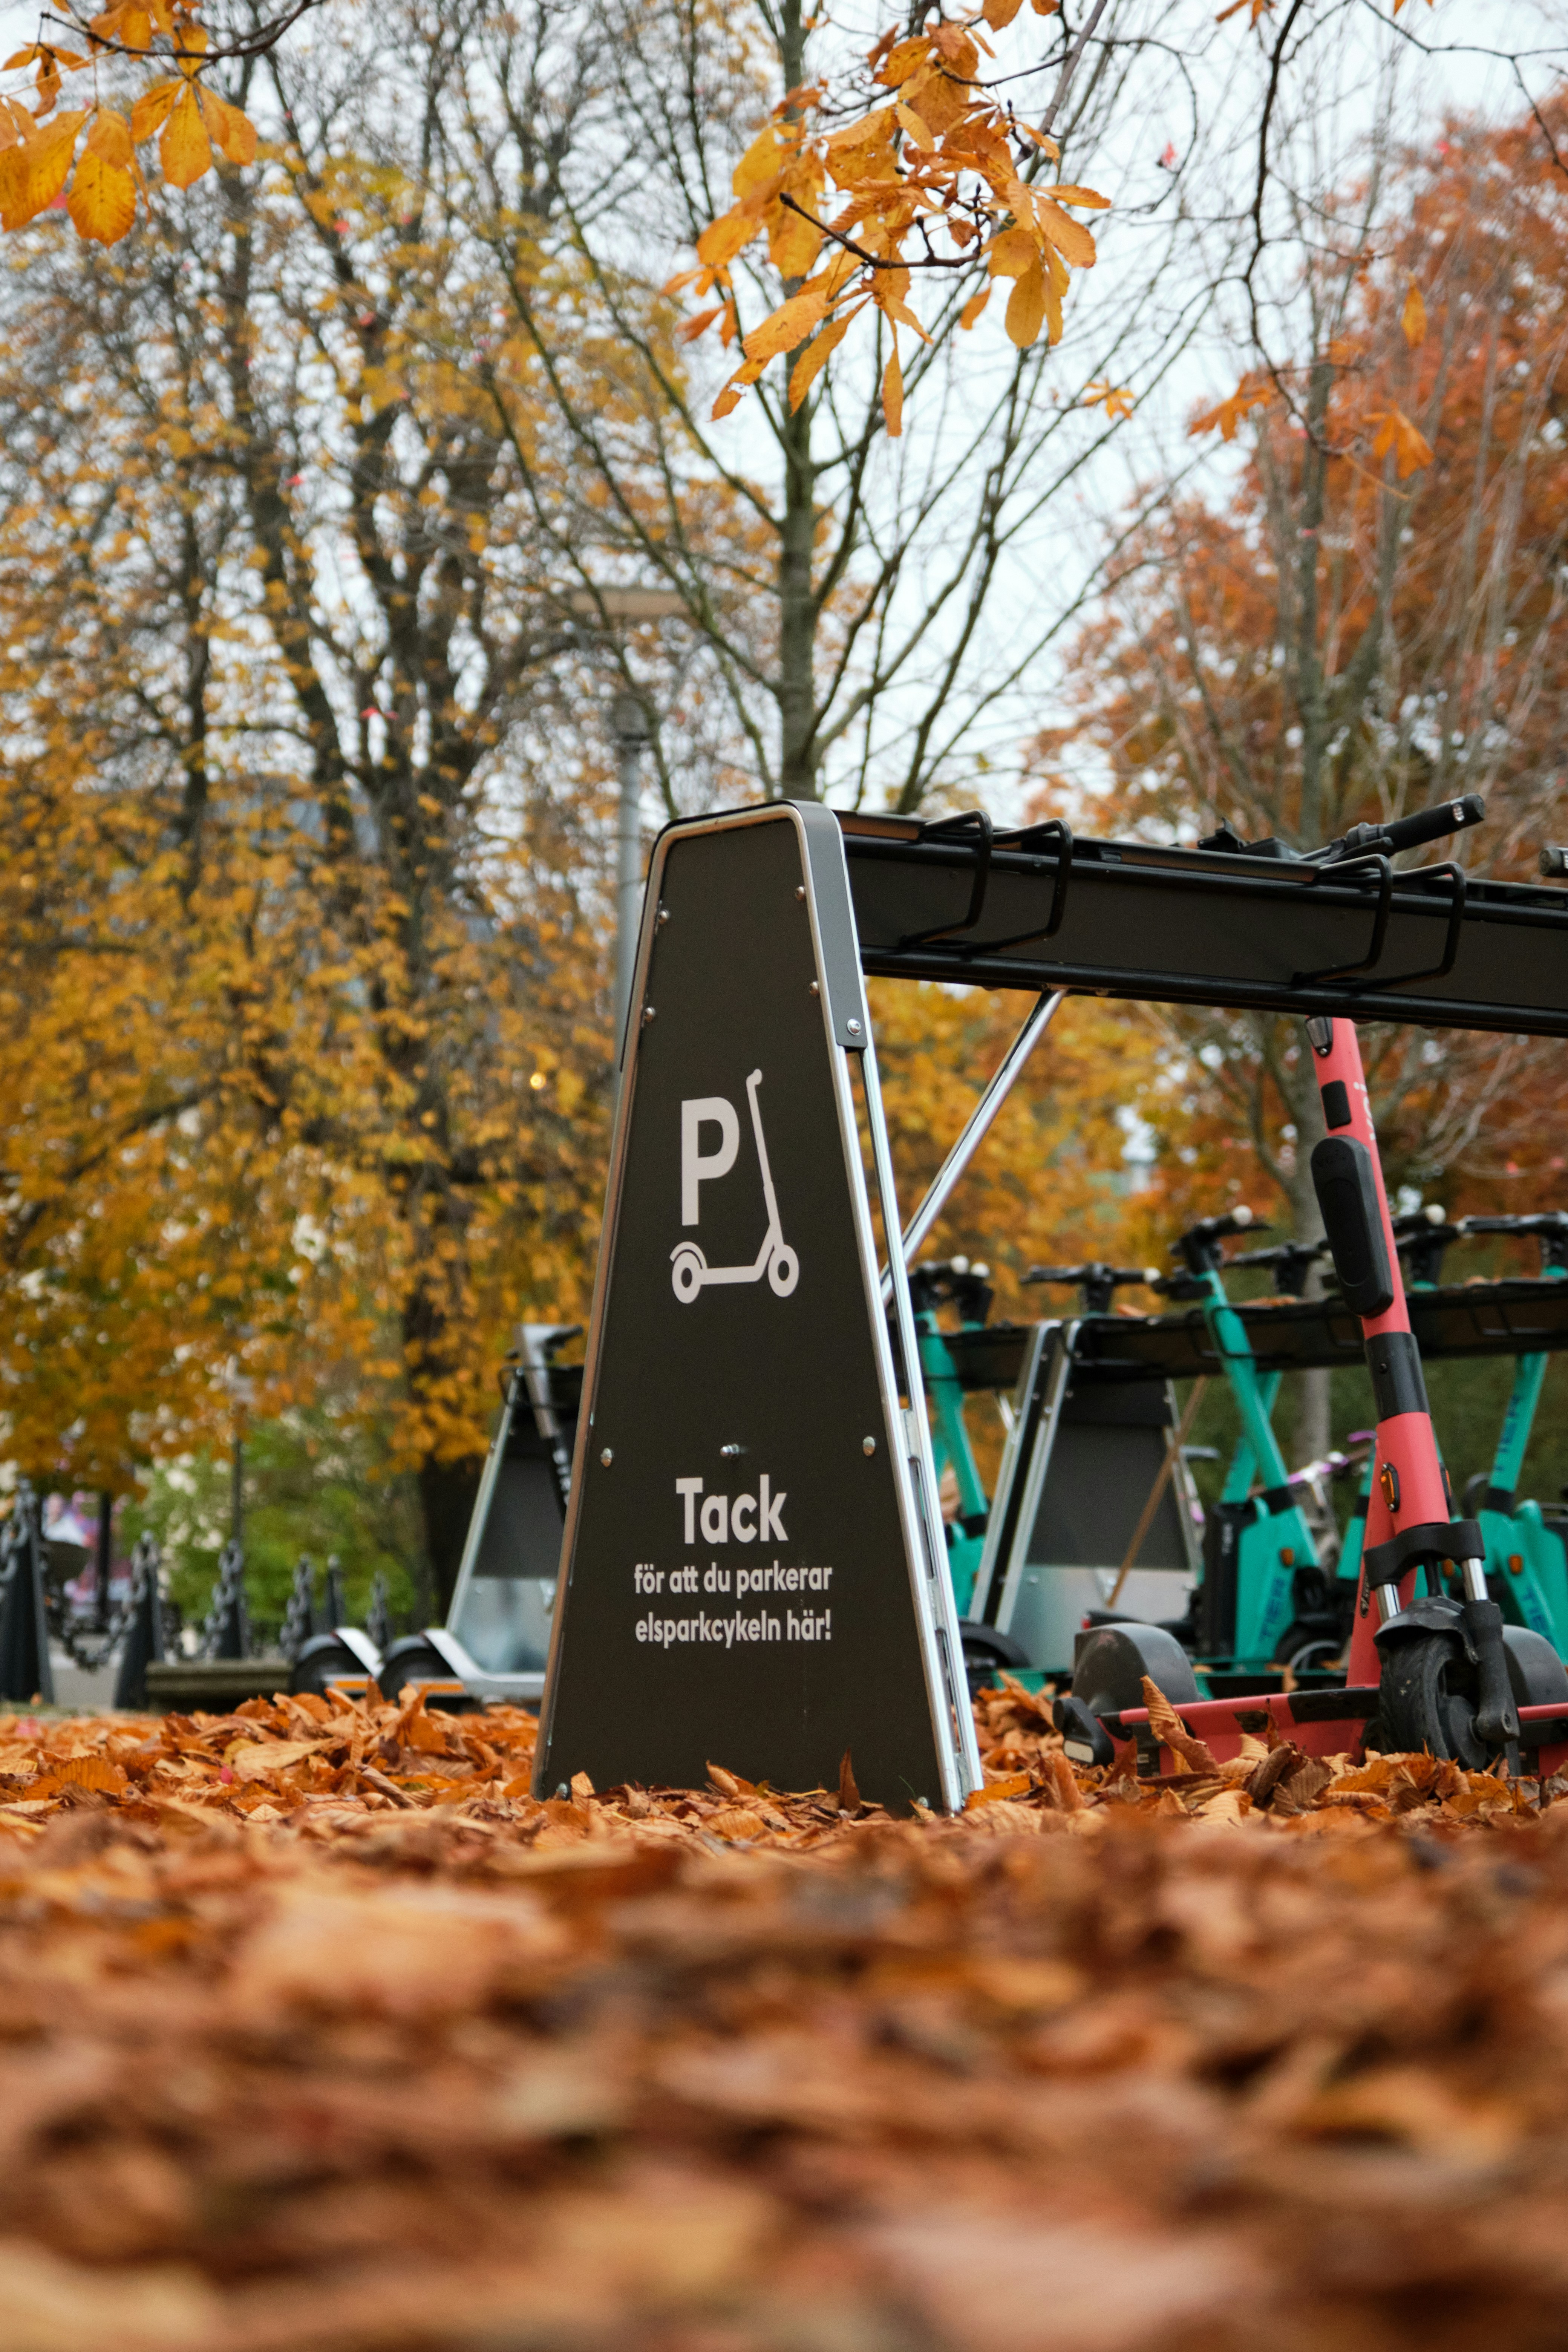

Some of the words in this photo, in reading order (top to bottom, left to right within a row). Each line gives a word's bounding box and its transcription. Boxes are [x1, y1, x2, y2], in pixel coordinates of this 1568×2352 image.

[681, 1096, 740, 1226] P
[675, 1473, 789, 1544] Tack
[634, 1563, 665, 1594] för
[669, 1565, 698, 1593] att
[703, 1562, 730, 1592] du
[737, 1560, 833, 1599] parkerar
[635, 1610, 781, 1649] elsparkcykeln
[787, 1609, 831, 1641] här!
